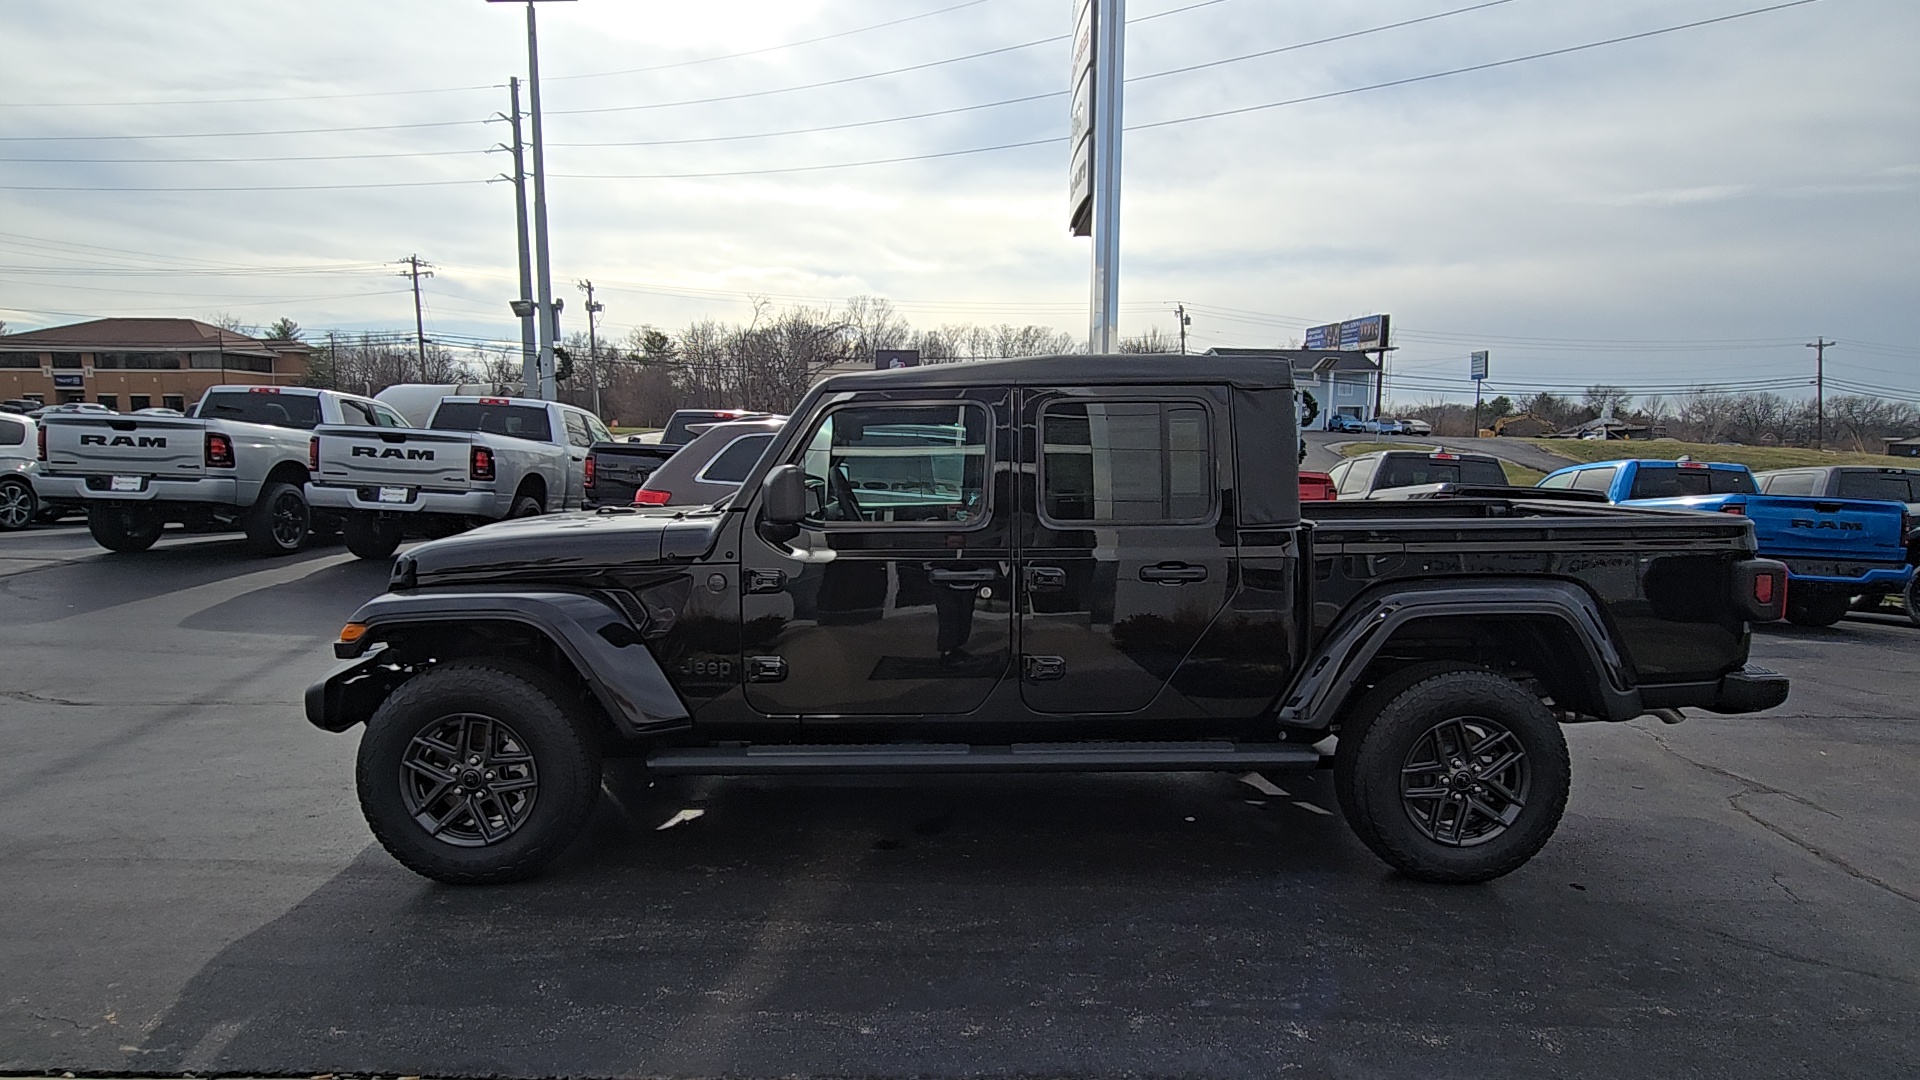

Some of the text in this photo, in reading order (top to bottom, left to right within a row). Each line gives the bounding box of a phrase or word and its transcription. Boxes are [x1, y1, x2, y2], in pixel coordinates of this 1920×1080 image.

[80, 435, 167, 448] RAM
[351, 446, 434, 461] RAM
[1791, 518, 1863, 531] RAM
[680, 657, 731, 678] Jeep
